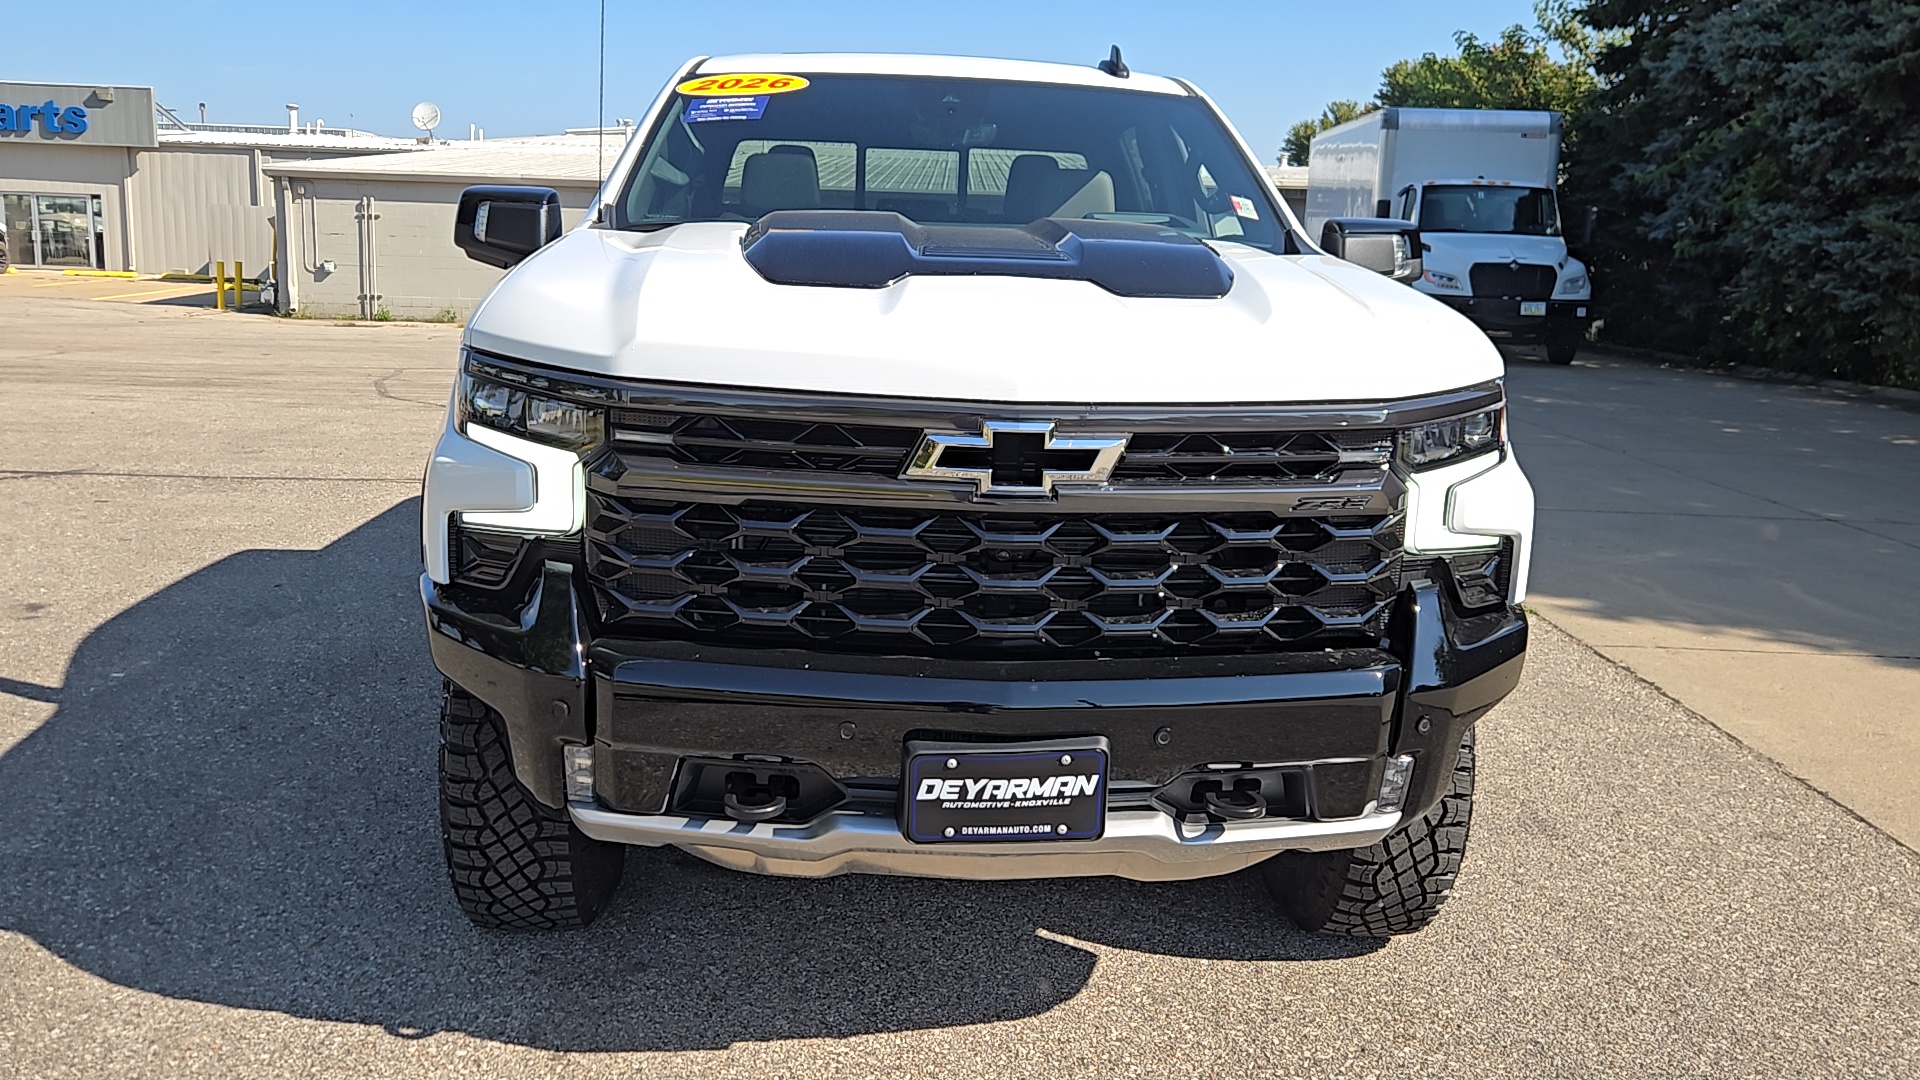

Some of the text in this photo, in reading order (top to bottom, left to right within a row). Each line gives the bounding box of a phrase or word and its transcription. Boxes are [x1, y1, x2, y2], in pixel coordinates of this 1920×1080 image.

[689, 78, 795, 92] 2026
[915, 774, 1101, 802] DEYARMAN
[961, 824, 1052, 835] DEYARMANAUTO.COM
